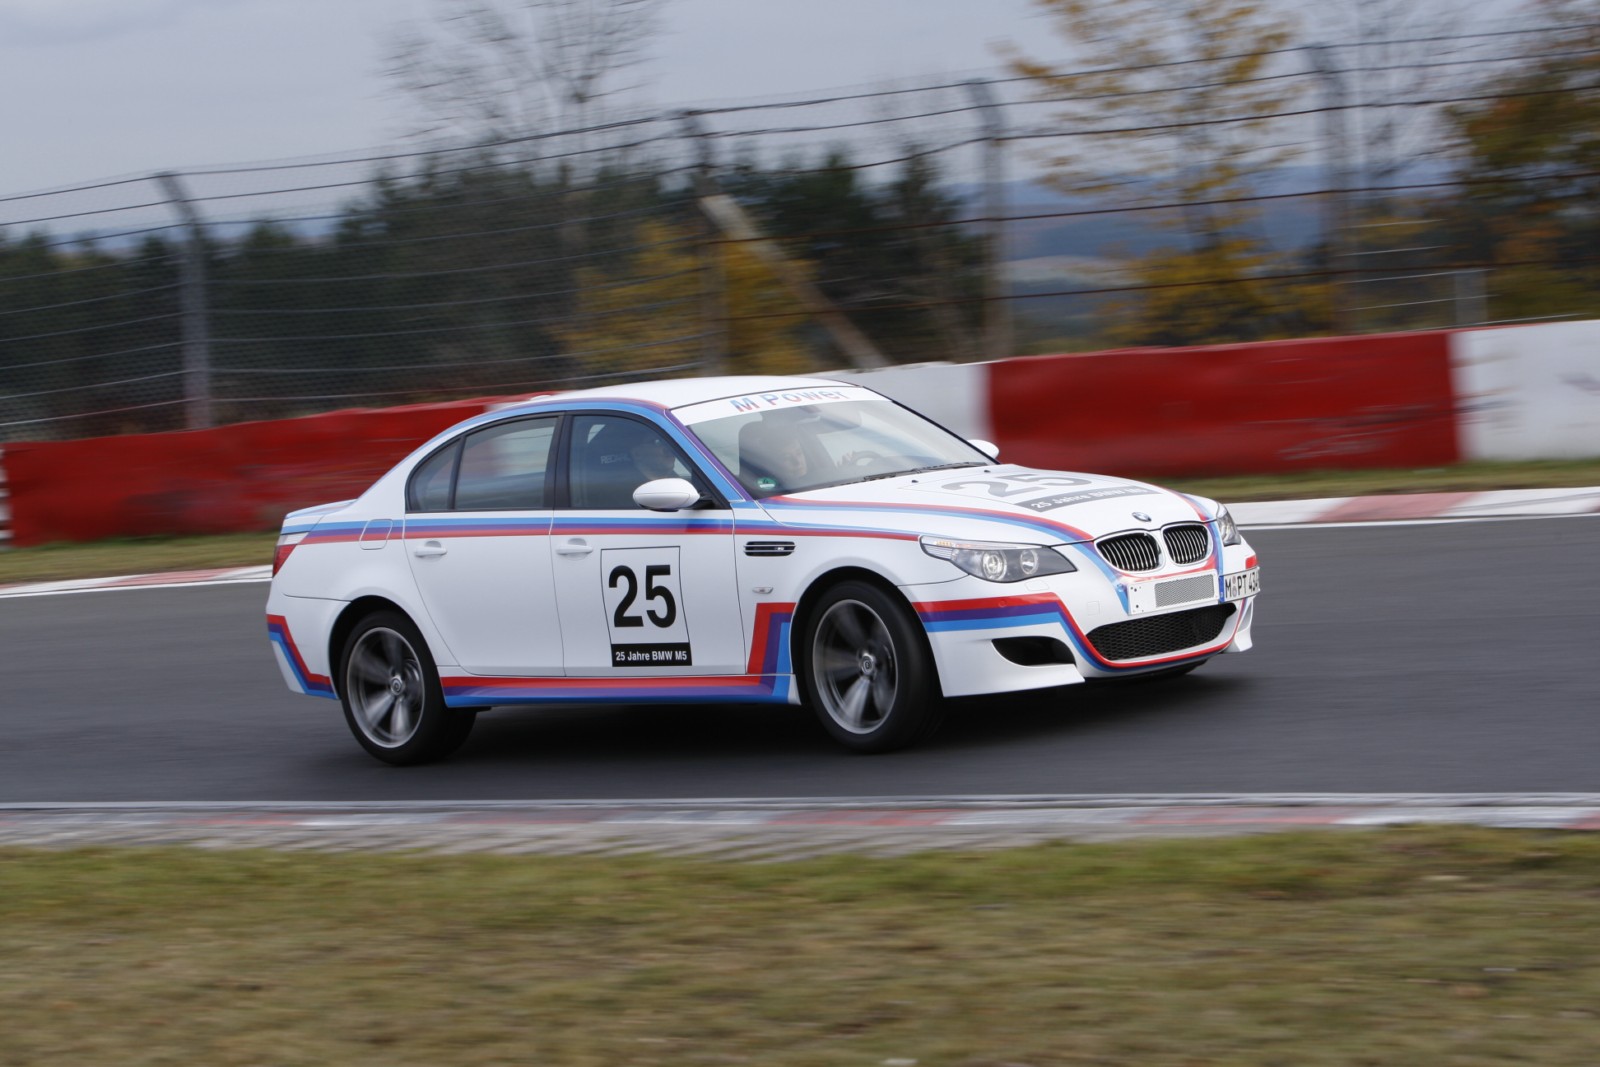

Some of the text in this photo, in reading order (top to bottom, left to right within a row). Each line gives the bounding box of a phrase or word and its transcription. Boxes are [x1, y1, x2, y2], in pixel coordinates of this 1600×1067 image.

[730, 391, 850, 412] M Power
[941, 473, 1092, 498] 25
[1031, 501, 1052, 509] 25
[608, 564, 676, 628] 25
[1225, 578, 1232, 599] M
[1237, 574, 1247, 596] PT
[615, 650, 688, 661] 25 Jahre BMW M5
